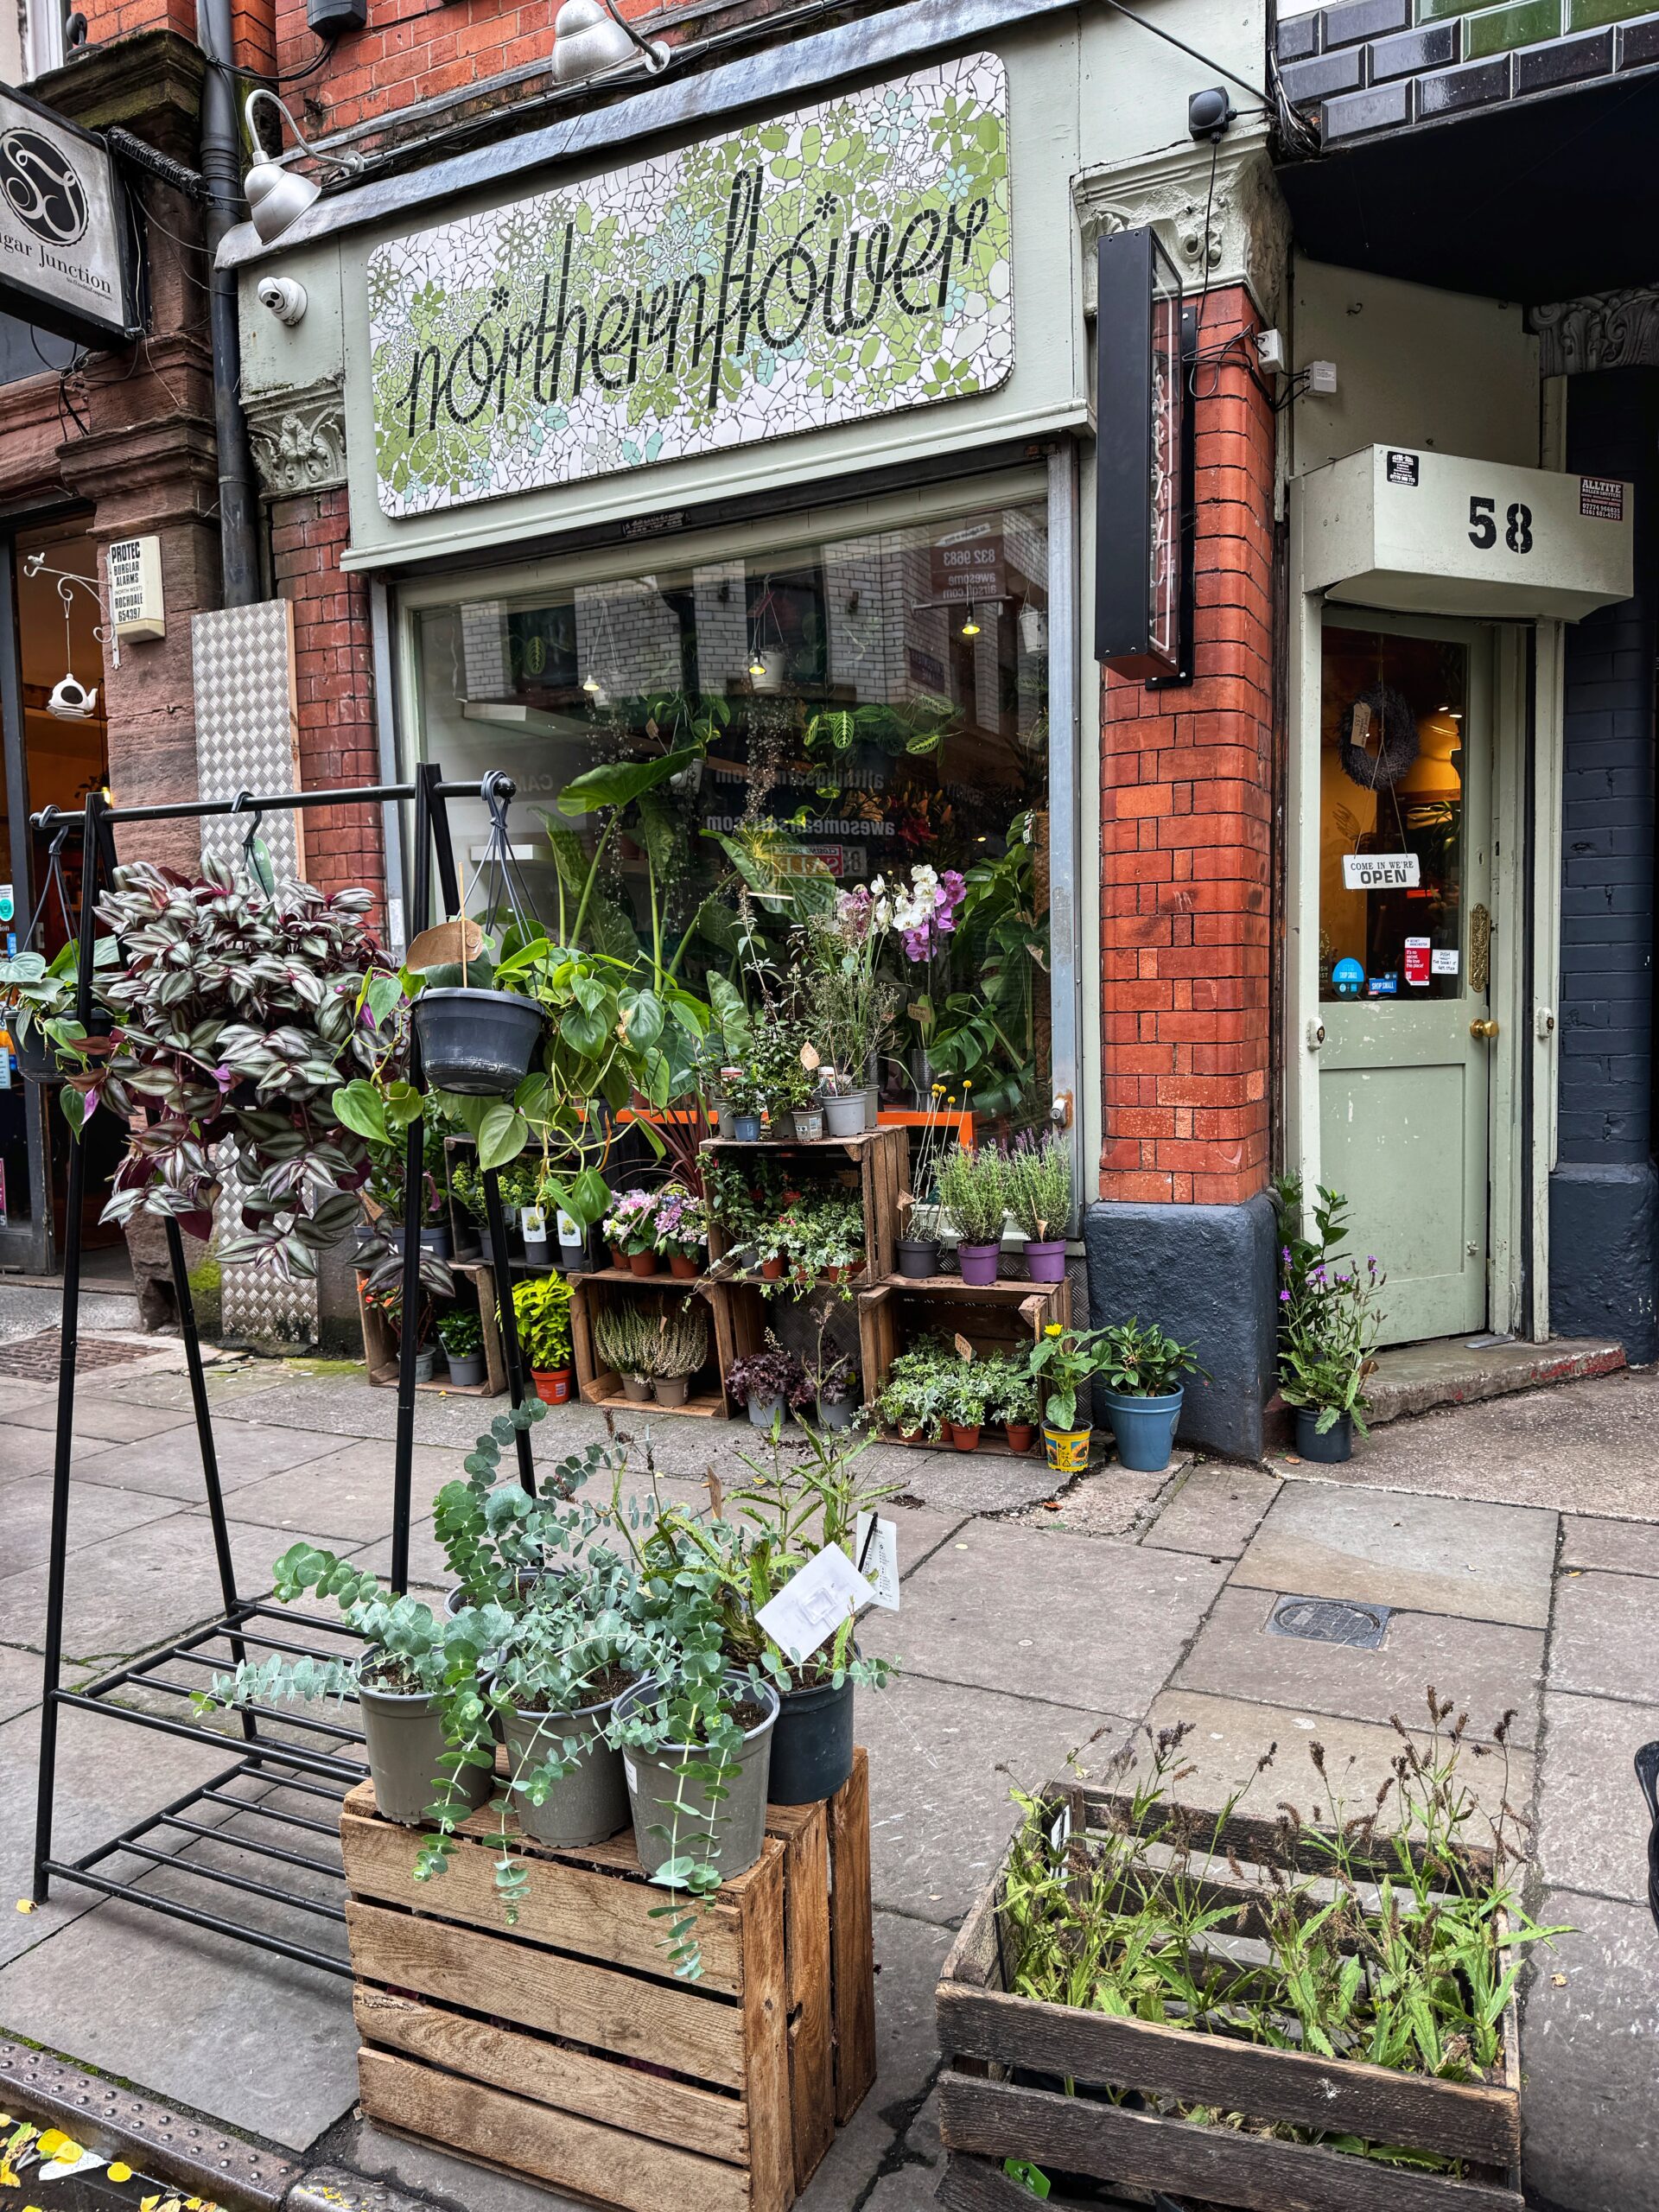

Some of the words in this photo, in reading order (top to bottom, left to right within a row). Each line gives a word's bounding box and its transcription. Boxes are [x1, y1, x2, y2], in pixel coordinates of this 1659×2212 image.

[39, 244, 111, 294] Junction
[1582, 480, 1621, 493] ALLTITE
[1468, 496, 1533, 554] 58
[111, 542, 140, 563] PROTEC
[113, 561, 139, 576] BURGLAR
[116, 573, 138, 587] ALARMS
[115, 593, 143, 608] ROCHDALE
[118, 607, 140, 622] 654397
[1389, 861, 1414, 869] WE'RE
[1361, 869, 1407, 884] OPEN
